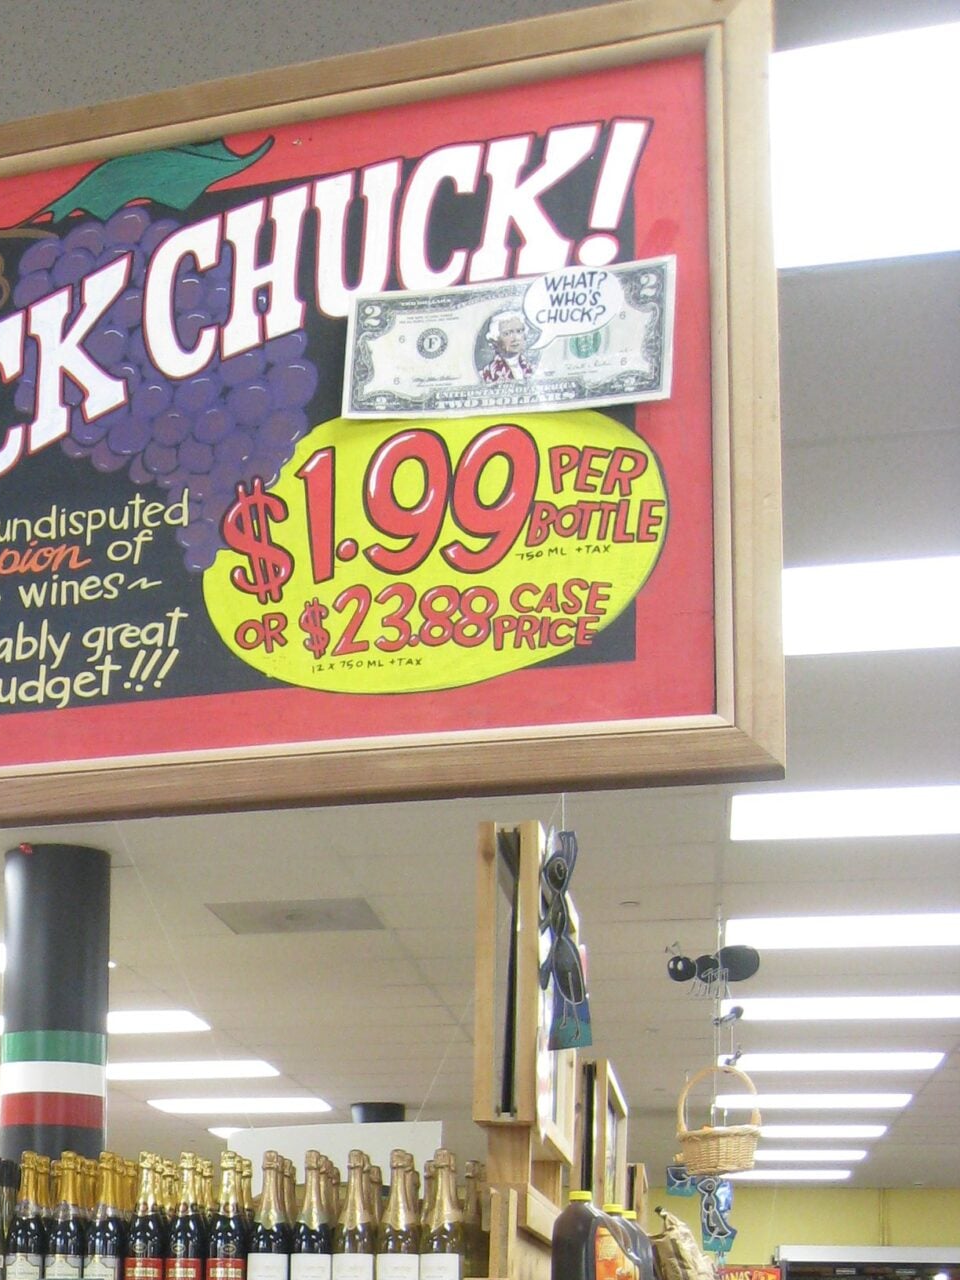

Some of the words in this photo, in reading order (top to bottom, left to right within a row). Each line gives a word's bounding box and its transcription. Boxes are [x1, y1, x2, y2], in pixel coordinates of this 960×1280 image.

[142, 117, 654, 380] CHUCK!
[543, 271, 608, 291] WHAT?
[549, 289, 602, 307] WHO'S
[536, 304, 606, 326] CHUCK?
[549, 445, 647, 497] PER
[221, 424, 539, 602] $1.99
[525, 500, 666, 547] BOTTLE
[107, 530, 155, 566] of
[511, 577, 612, 615] CASE
[81, 606, 190, 666] great
[235, 611, 288, 653] OR
[299, 582, 497, 659] $23.88
[493, 614, 601, 652] PRICE
